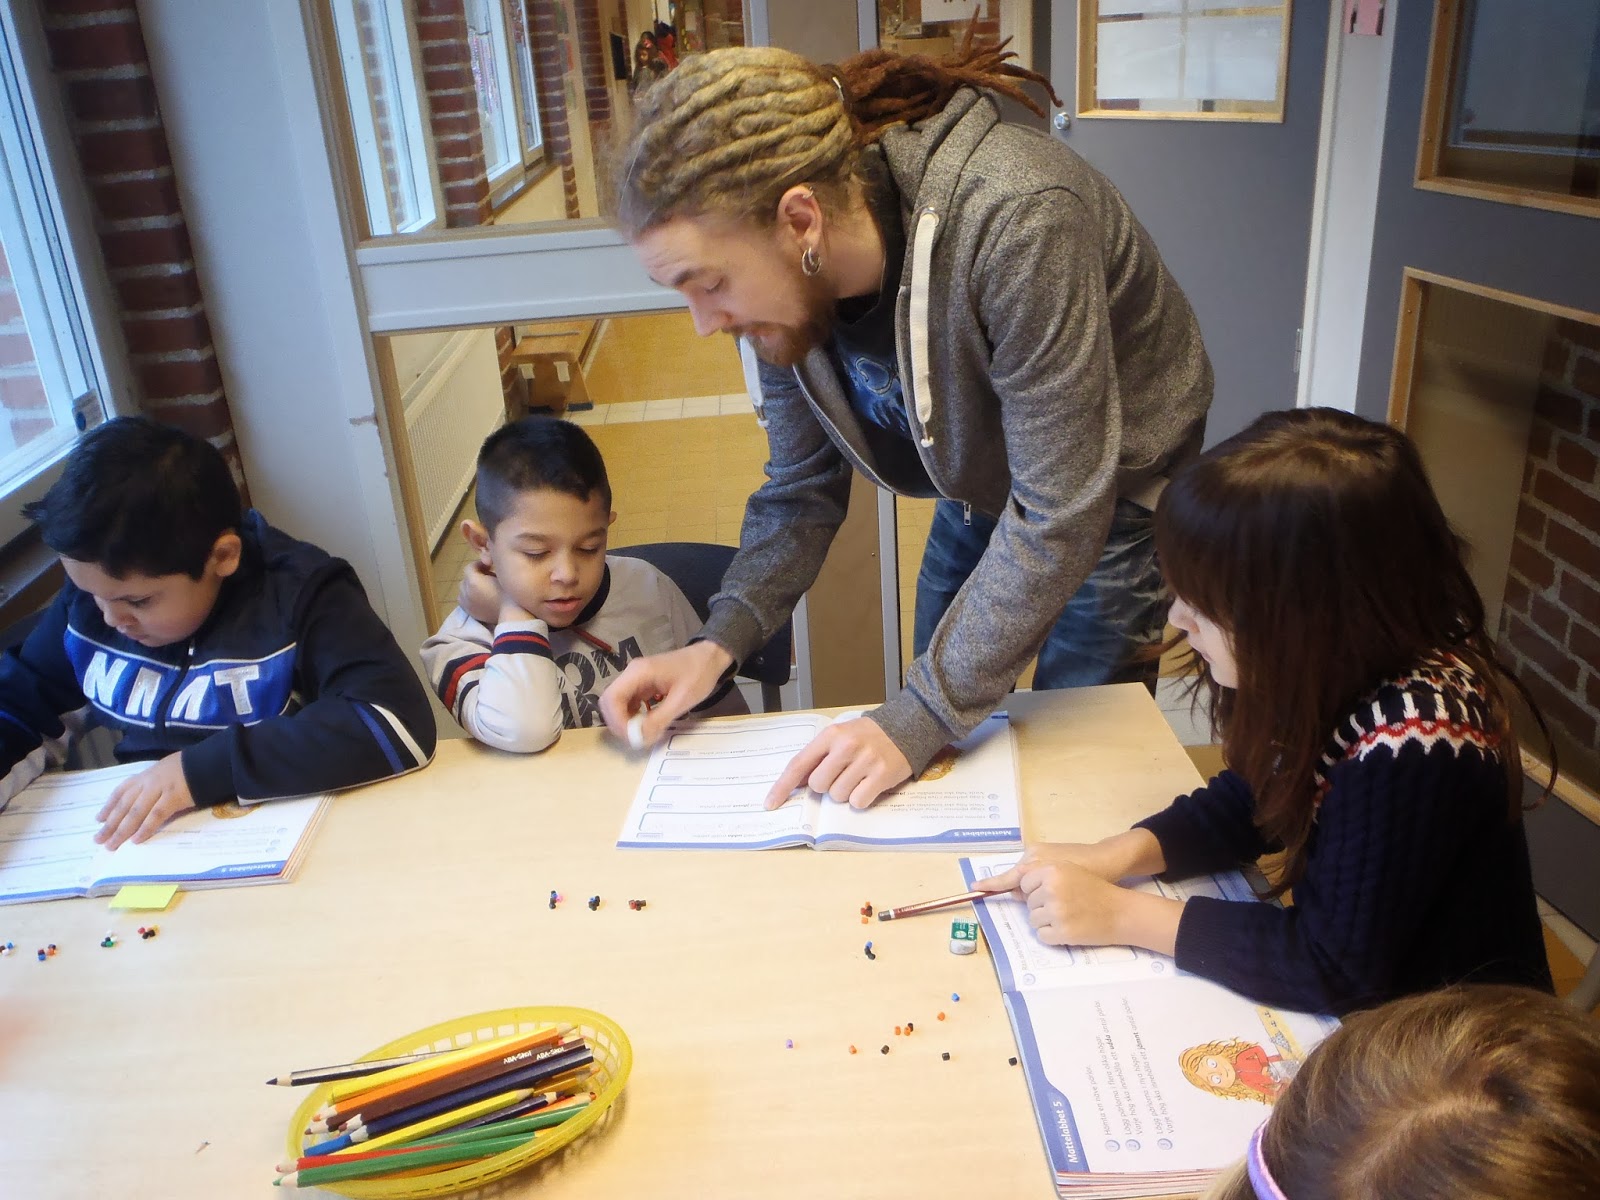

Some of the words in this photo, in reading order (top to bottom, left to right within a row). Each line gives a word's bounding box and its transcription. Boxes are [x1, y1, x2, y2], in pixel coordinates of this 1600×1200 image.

[1105, 1035, 1114, 1049] udda
[1133, 1032, 1145, 1050] jämnt
[1154, 1091, 1162, 1100] ska
[1055, 1108, 1078, 1163] Mattelabbet
